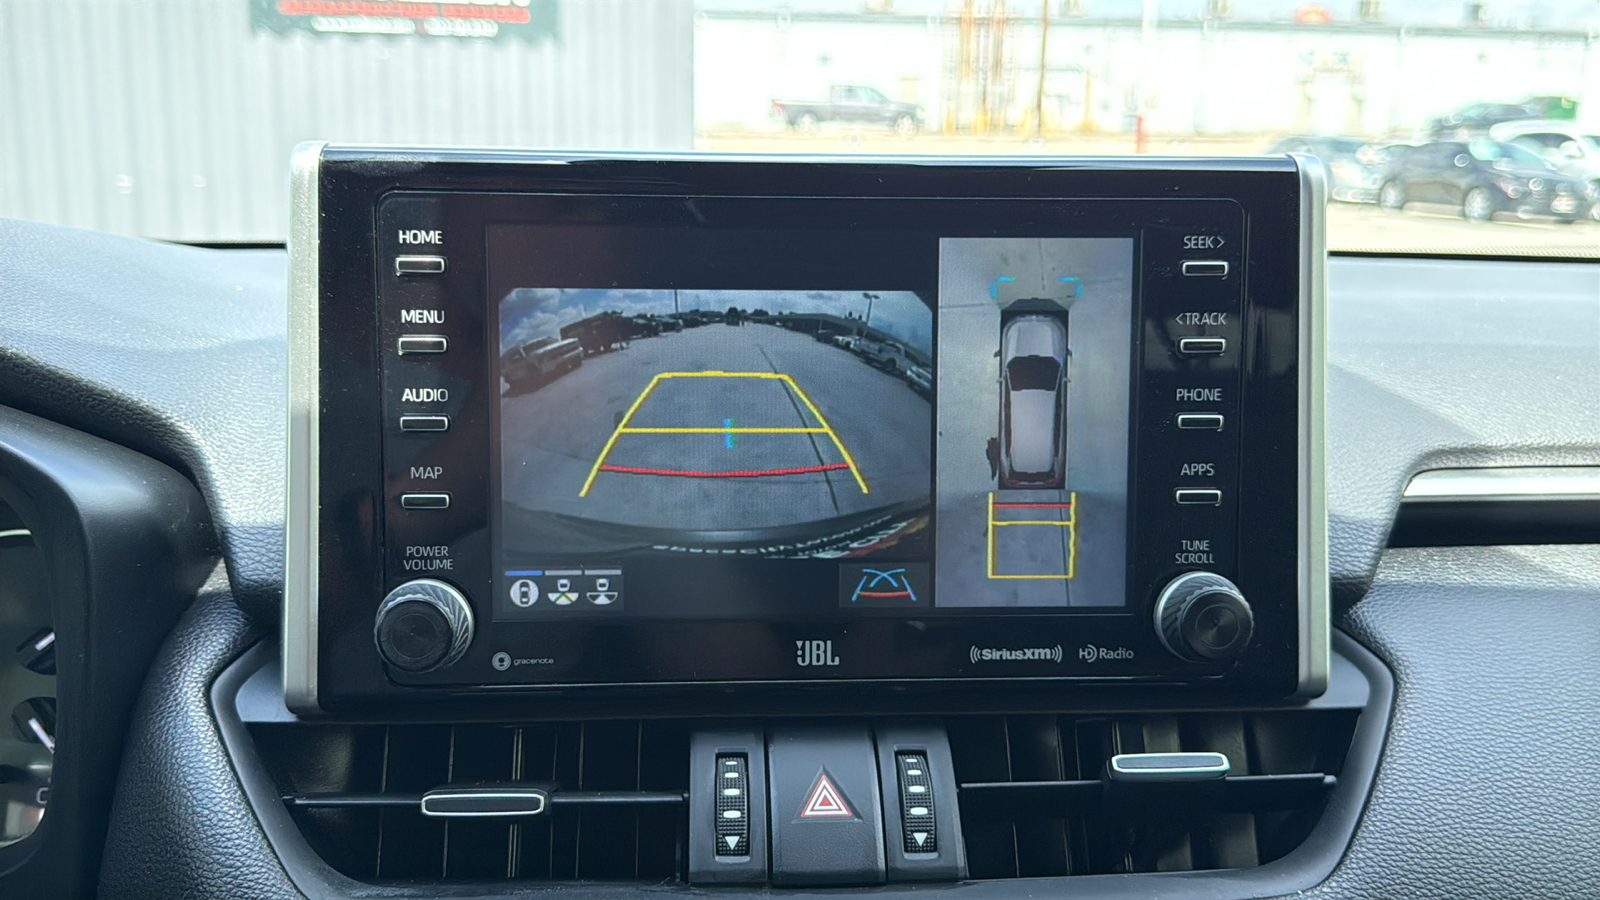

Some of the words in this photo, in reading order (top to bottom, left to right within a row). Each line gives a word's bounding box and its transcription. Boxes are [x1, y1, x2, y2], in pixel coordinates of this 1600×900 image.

[399, 230, 442, 244] HOME
[401, 310, 444, 323] MENU
[402, 388, 448, 402] AUDIO
[1177, 388, 1221, 401] PHONE
[411, 467, 442, 479] MAP
[1181, 463, 1214, 476] APPS
[407, 546, 448, 557] POWER
[1181, 540, 1209, 551] TUNE
[1175, 553, 1214, 563] SCROLL
[403, 559, 453, 570] VOLUME
[796, 640, 839, 666] JBL
[1099, 647, 1133, 659] Radio
[513, 658, 554, 666] gracenote
